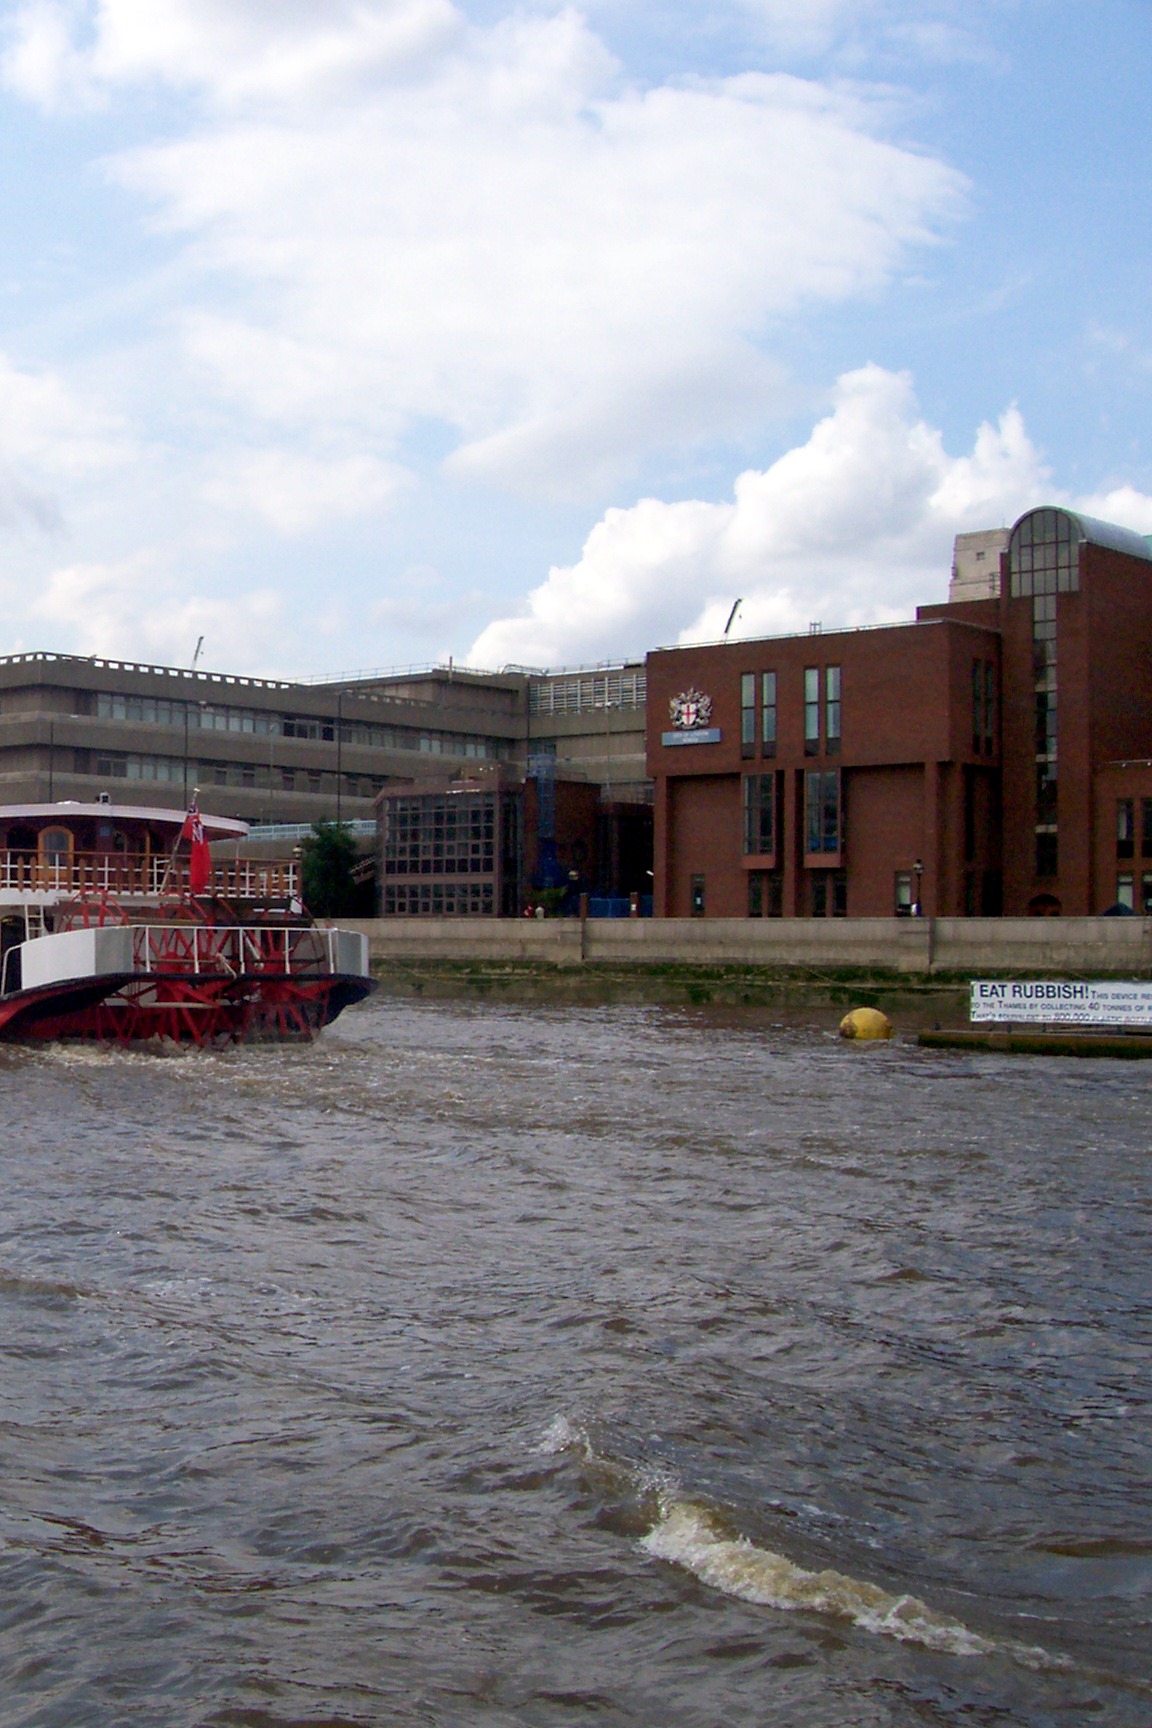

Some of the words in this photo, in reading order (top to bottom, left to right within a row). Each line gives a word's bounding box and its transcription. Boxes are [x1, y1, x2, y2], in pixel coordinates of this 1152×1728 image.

[979, 984, 1007, 998] EAT
[1012, 984, 1089, 999] RUBBISH!
[998, 1000, 1027, 1009] THAMES
[1040, 1003, 1086, 1011] COLLECTING
[1088, 1002, 1100, 1011] 40
[1102, 1004, 1132, 1012] TONNES
